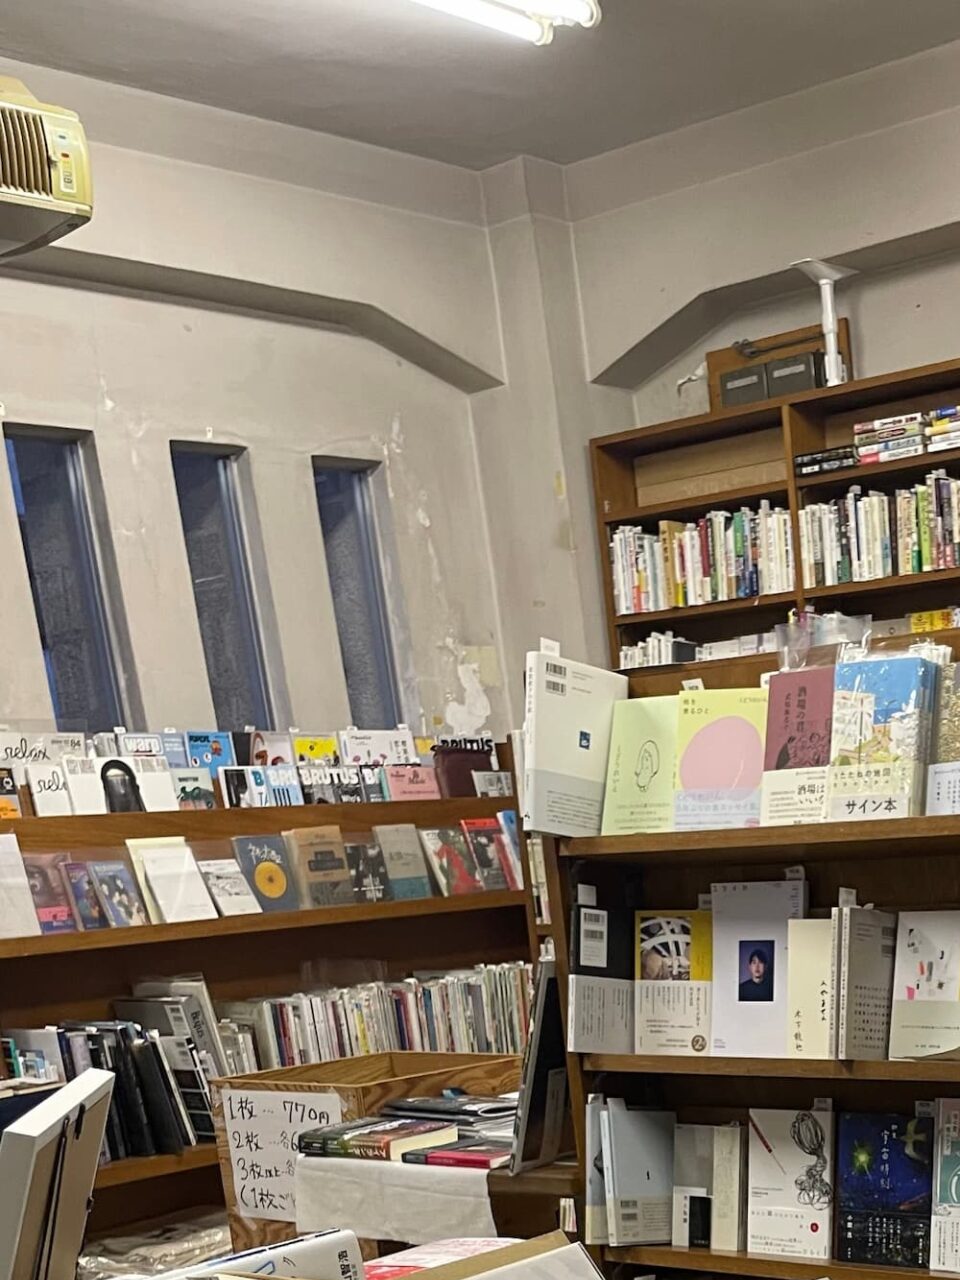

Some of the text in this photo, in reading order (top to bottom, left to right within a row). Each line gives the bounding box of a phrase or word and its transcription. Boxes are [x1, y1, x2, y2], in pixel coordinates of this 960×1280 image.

[300, 767, 360, 786] BRUTUS
[845, 798, 898, 815] サイン本
[227, 1097, 330, 1125] 1枚 770円
